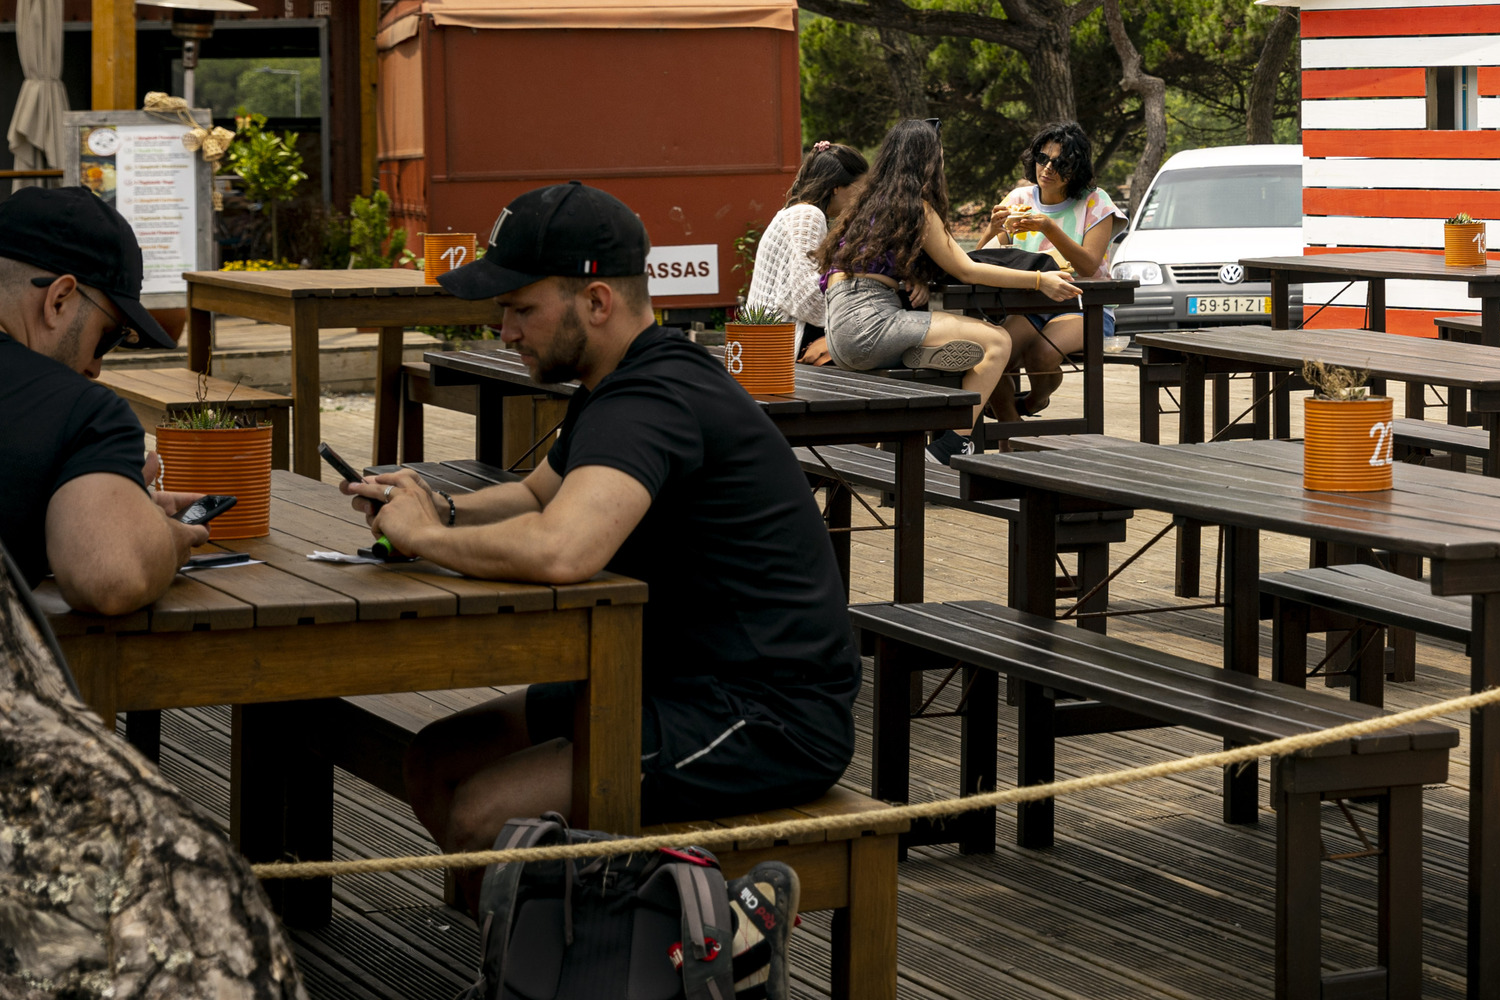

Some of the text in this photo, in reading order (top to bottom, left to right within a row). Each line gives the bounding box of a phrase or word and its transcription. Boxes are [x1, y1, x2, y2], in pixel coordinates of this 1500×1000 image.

[440, 246, 467, 270] 12
[725, 341, 743, 374] 18
[740, 886, 777, 930] Red Chili
